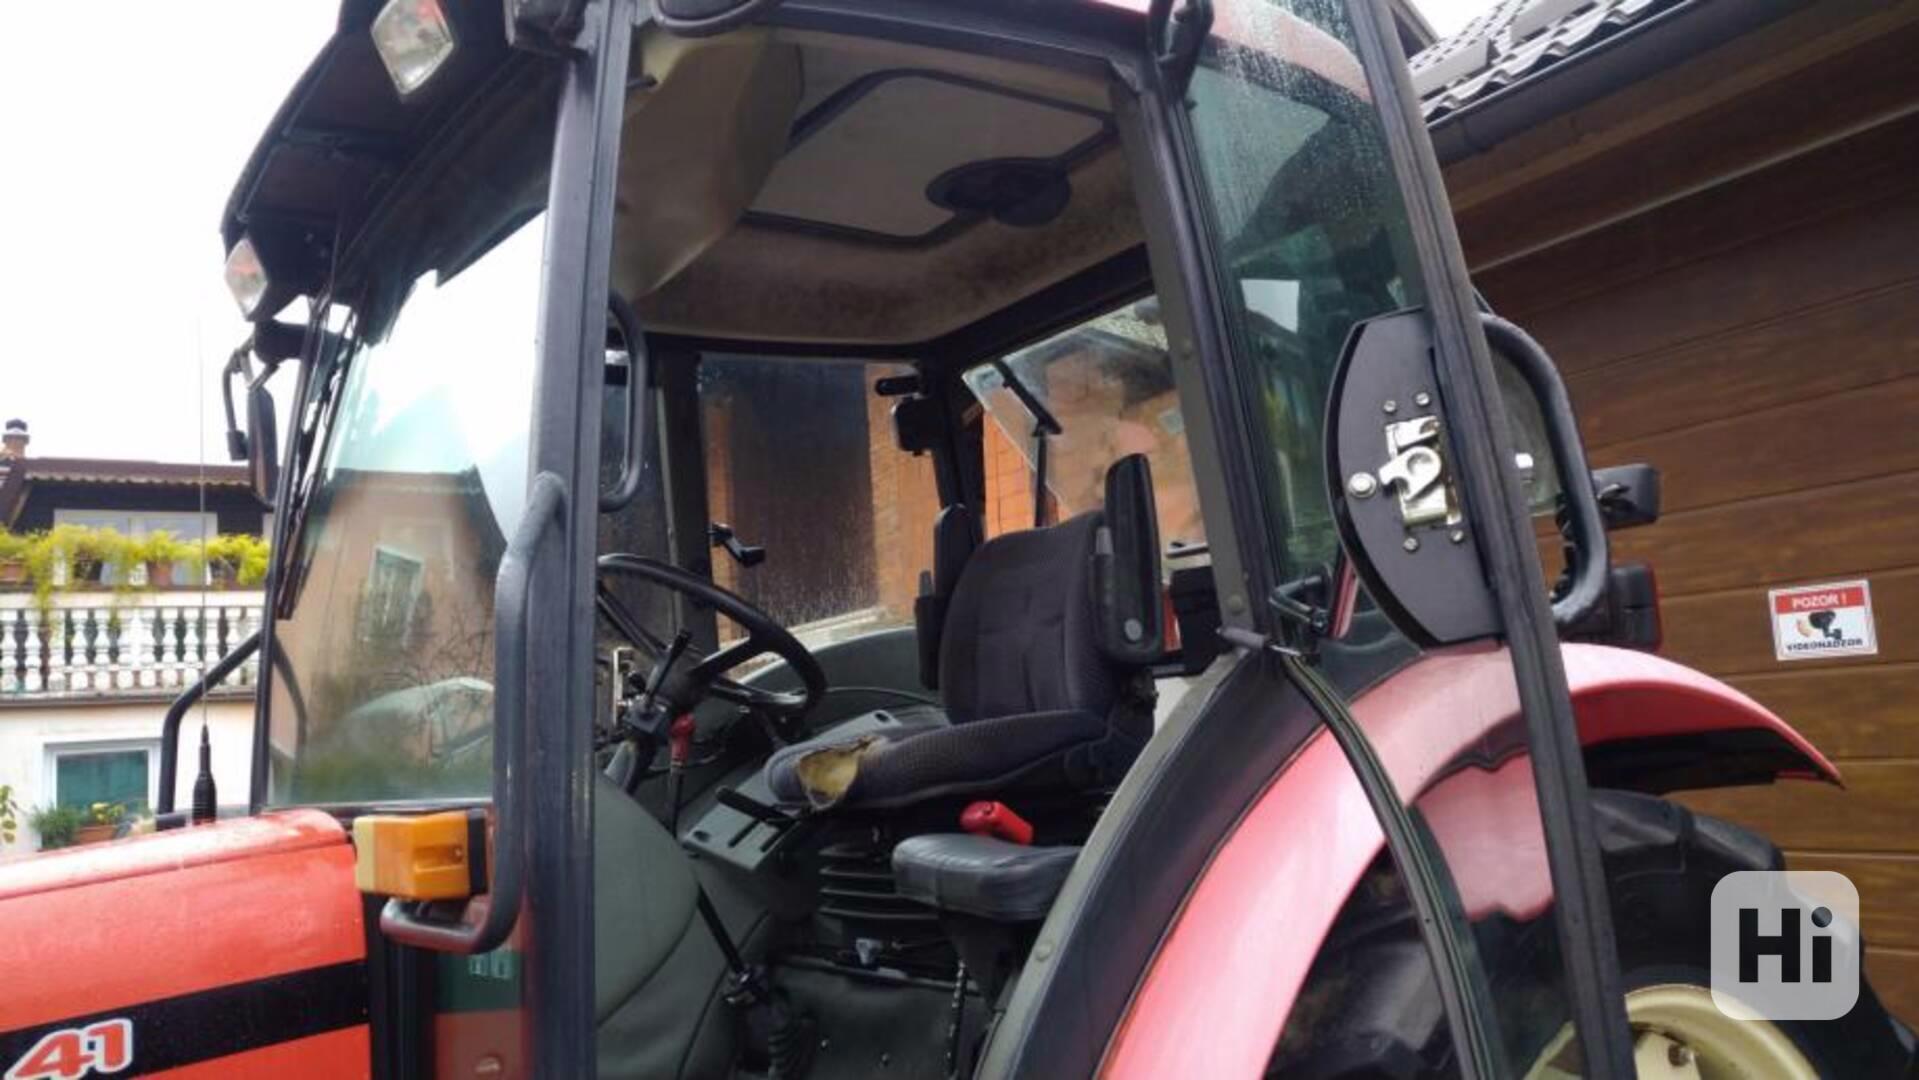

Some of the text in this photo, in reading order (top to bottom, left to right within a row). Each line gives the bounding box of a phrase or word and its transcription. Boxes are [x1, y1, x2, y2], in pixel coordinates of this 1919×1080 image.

[1791, 593, 1840, 609] POZOR
[1786, 638, 1863, 651] VIDEONADZOR
[4, 1018, 133, 1080] 41
